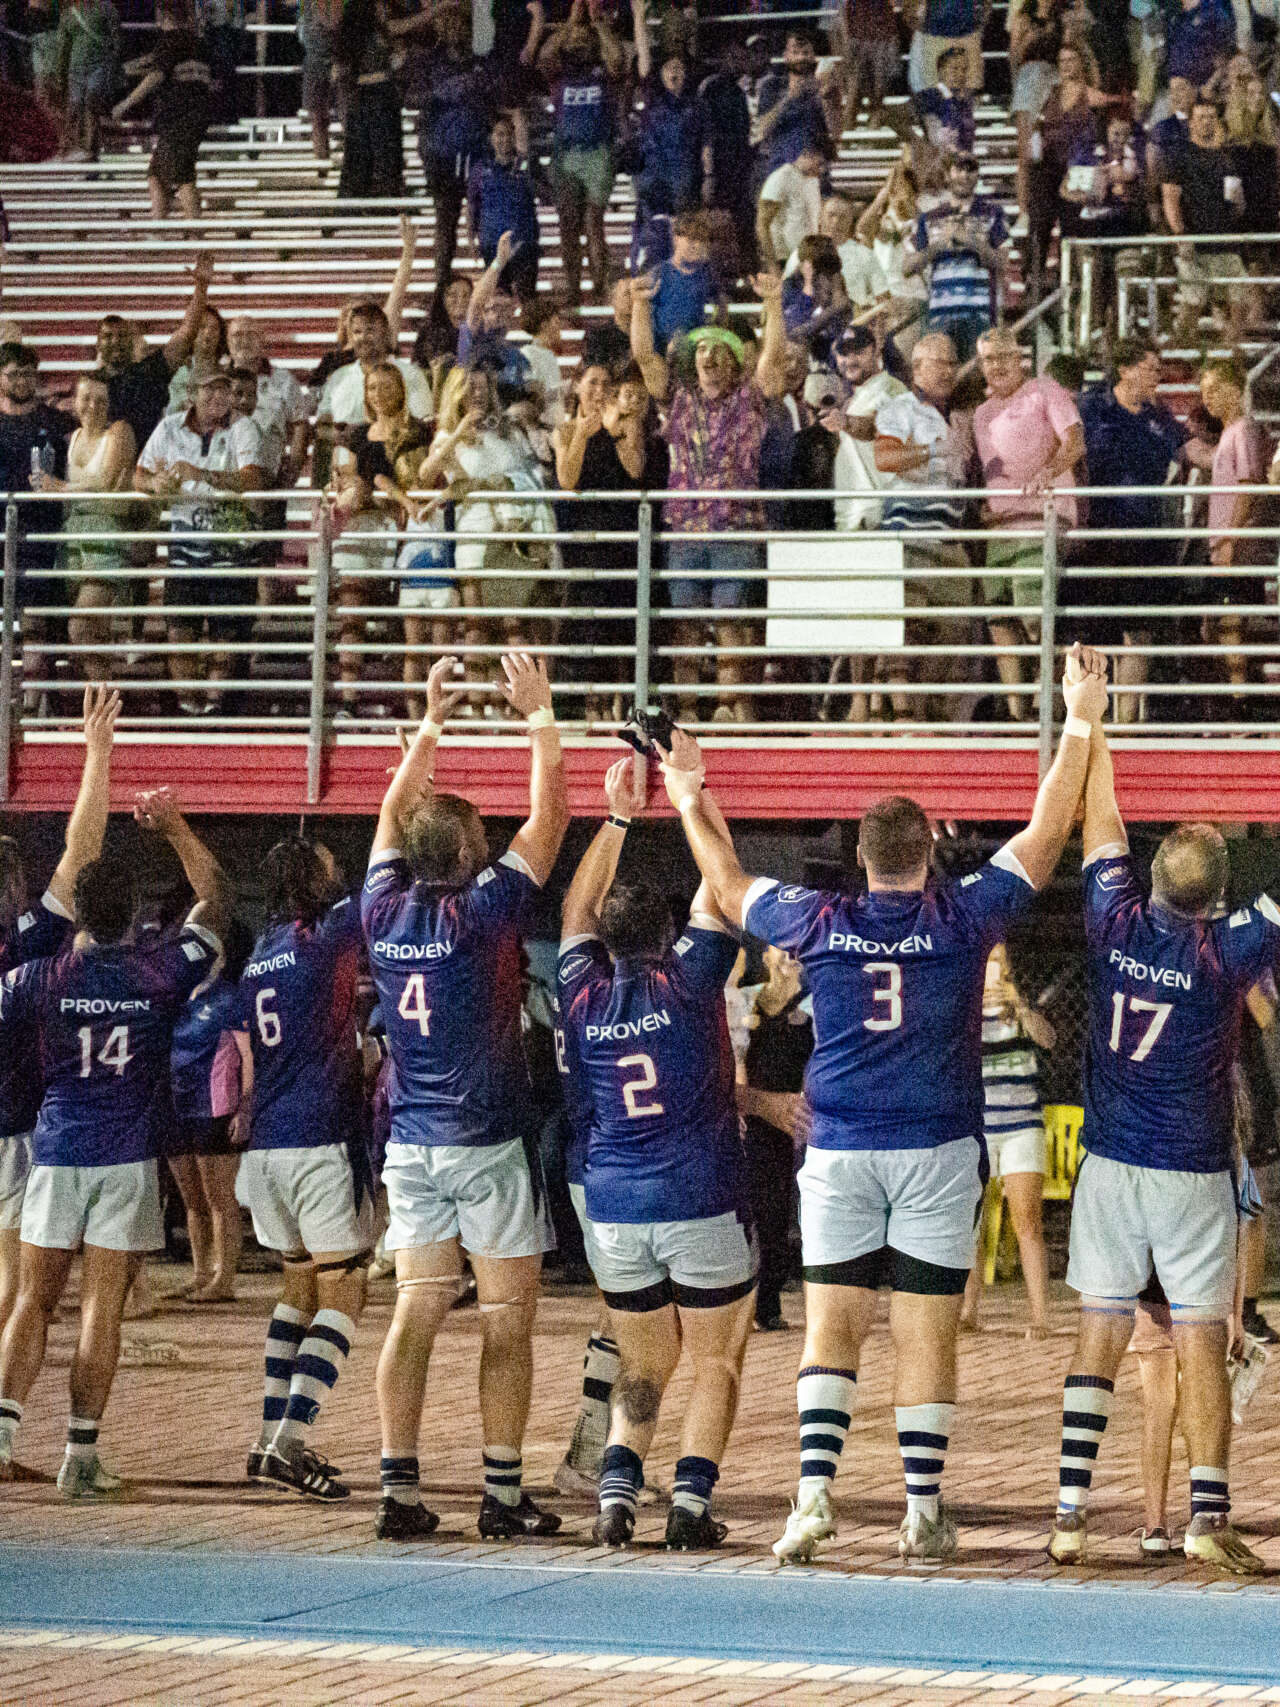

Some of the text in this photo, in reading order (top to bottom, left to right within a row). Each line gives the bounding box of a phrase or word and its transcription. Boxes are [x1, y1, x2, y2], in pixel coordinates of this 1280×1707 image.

[374, 941, 453, 959] PROVEN
[828, 933, 933, 954] PROVEN
[1110, 949, 1191, 990] PROVEN
[60, 998, 150, 1013] PROVEN
[256, 988, 281, 1046] 6
[398, 974, 431, 1036] 4
[863, 963, 902, 1031] 3
[586, 1009, 671, 1041] PROVEN
[1109, 992, 1173, 1061] 17
[78, 1026, 133, 1077] 14
[615, 1054, 663, 1117] 2
